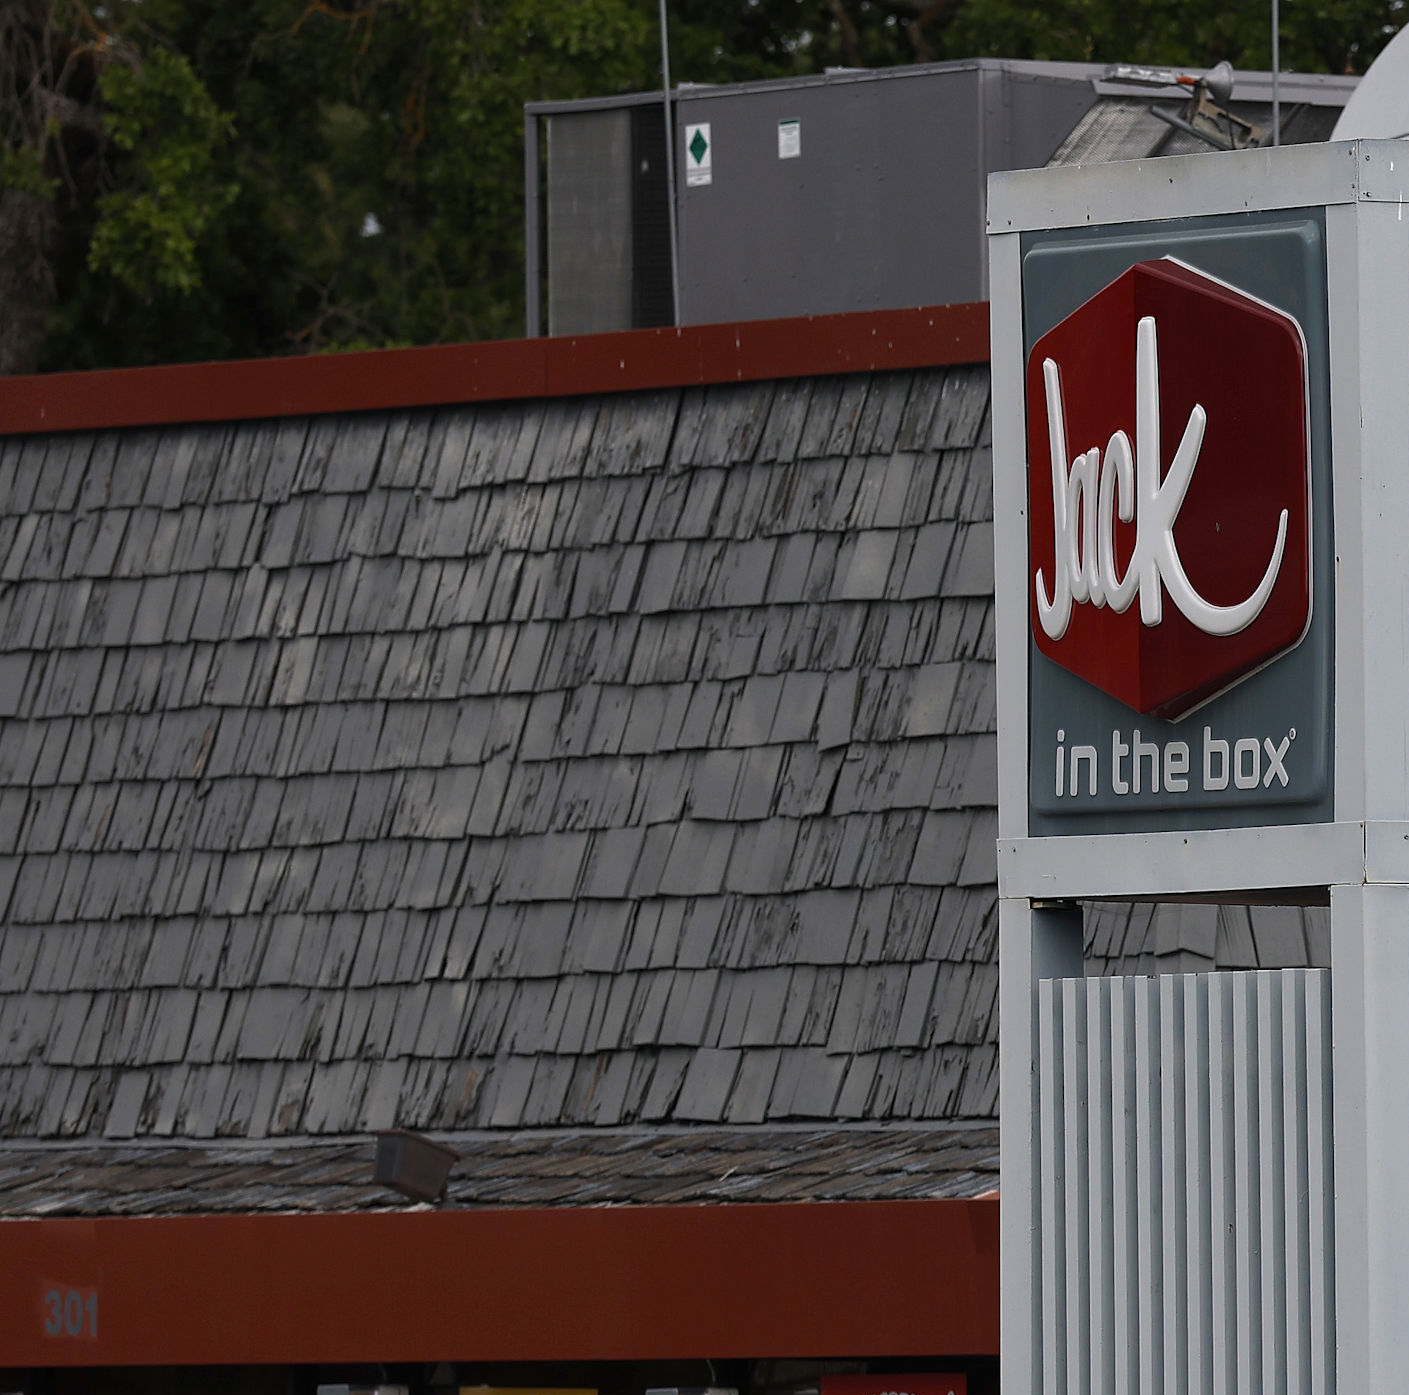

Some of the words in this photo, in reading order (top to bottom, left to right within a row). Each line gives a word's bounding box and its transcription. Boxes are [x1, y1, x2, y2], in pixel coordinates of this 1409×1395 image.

[1036, 315, 1288, 641] Jack
[1055, 730, 1097, 796] in
[1111, 728, 1189, 794] the
[44, 1289, 98, 1337] 301
